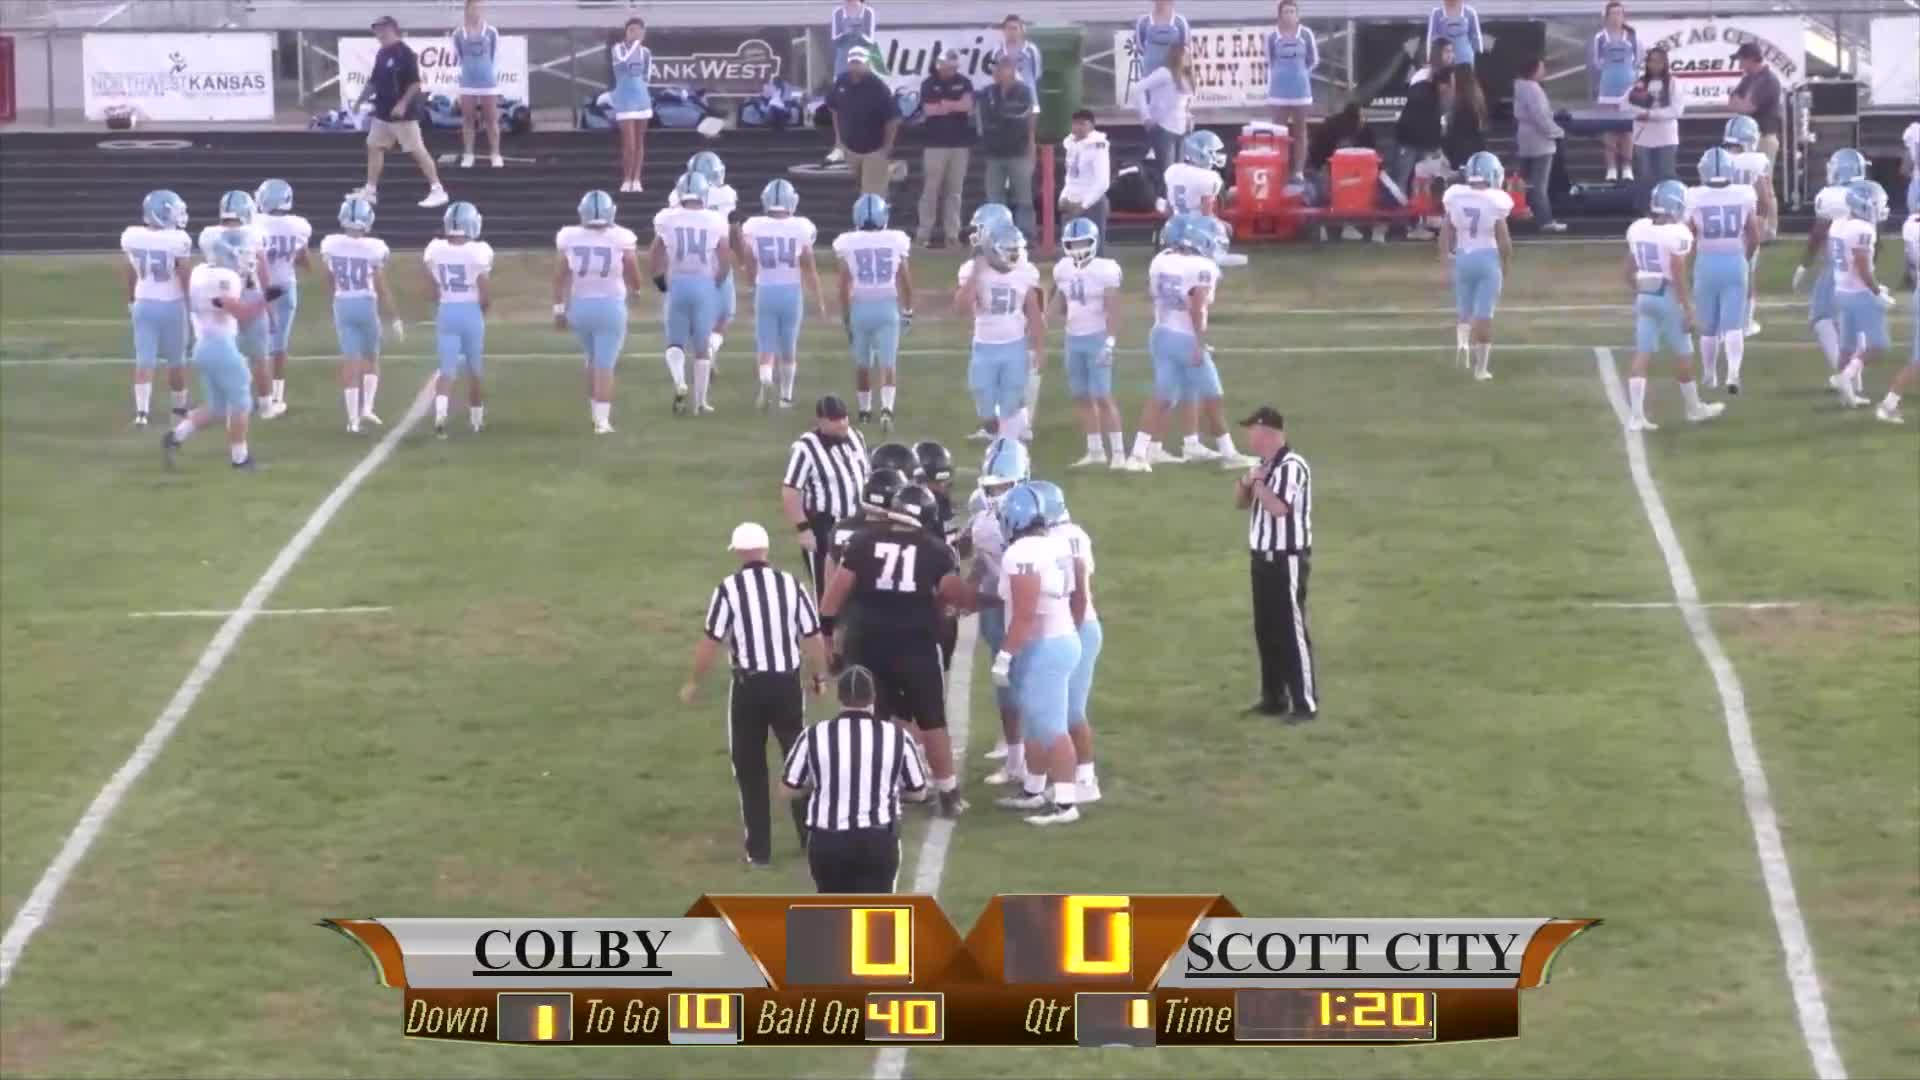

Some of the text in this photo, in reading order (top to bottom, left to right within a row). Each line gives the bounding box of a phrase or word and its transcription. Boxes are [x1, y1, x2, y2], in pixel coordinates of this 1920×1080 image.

[1687, 27, 1716, 44] AG
[419, 46, 460, 68] Clu
[1671, 58, 1724, 71] CASE
[648, 64, 697, 79] ANK
[1192, 63, 1243, 87] ALTY,
[1463, 207, 1481, 239] 7
[673, 226, 708, 264] 14
[572, 246, 612, 278] 77
[437, 263, 470, 293] 12
[874, 541, 917, 592] 71
